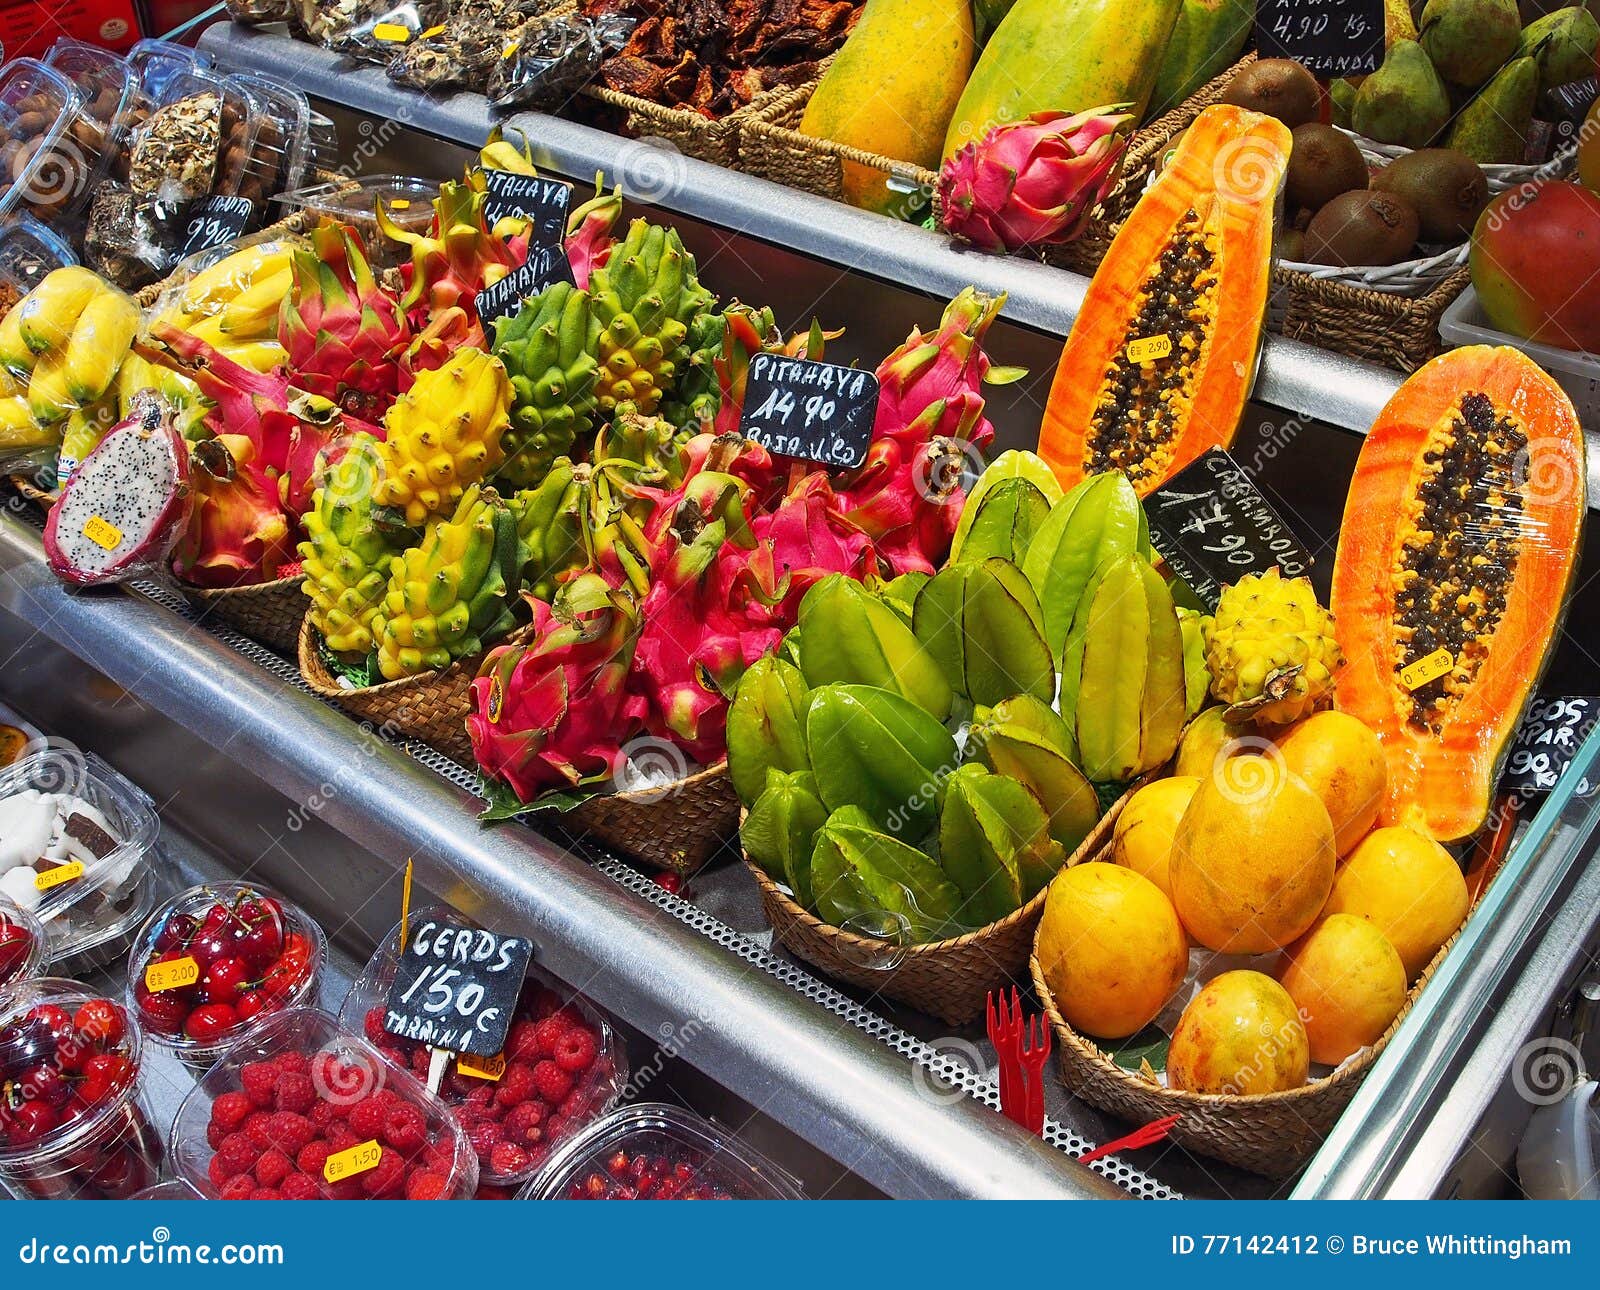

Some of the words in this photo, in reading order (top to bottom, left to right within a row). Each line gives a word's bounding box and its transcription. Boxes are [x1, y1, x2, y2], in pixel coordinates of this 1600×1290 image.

[1273, 13, 1328, 43] 4,90
[1148, 340, 1169, 354] 2.90
[753, 356, 866, 400] PITAHAYA
[412, 922, 519, 972] GERDS
[171, 965, 195, 982] 2.00
[353, 1148, 378, 1168] 1.50
